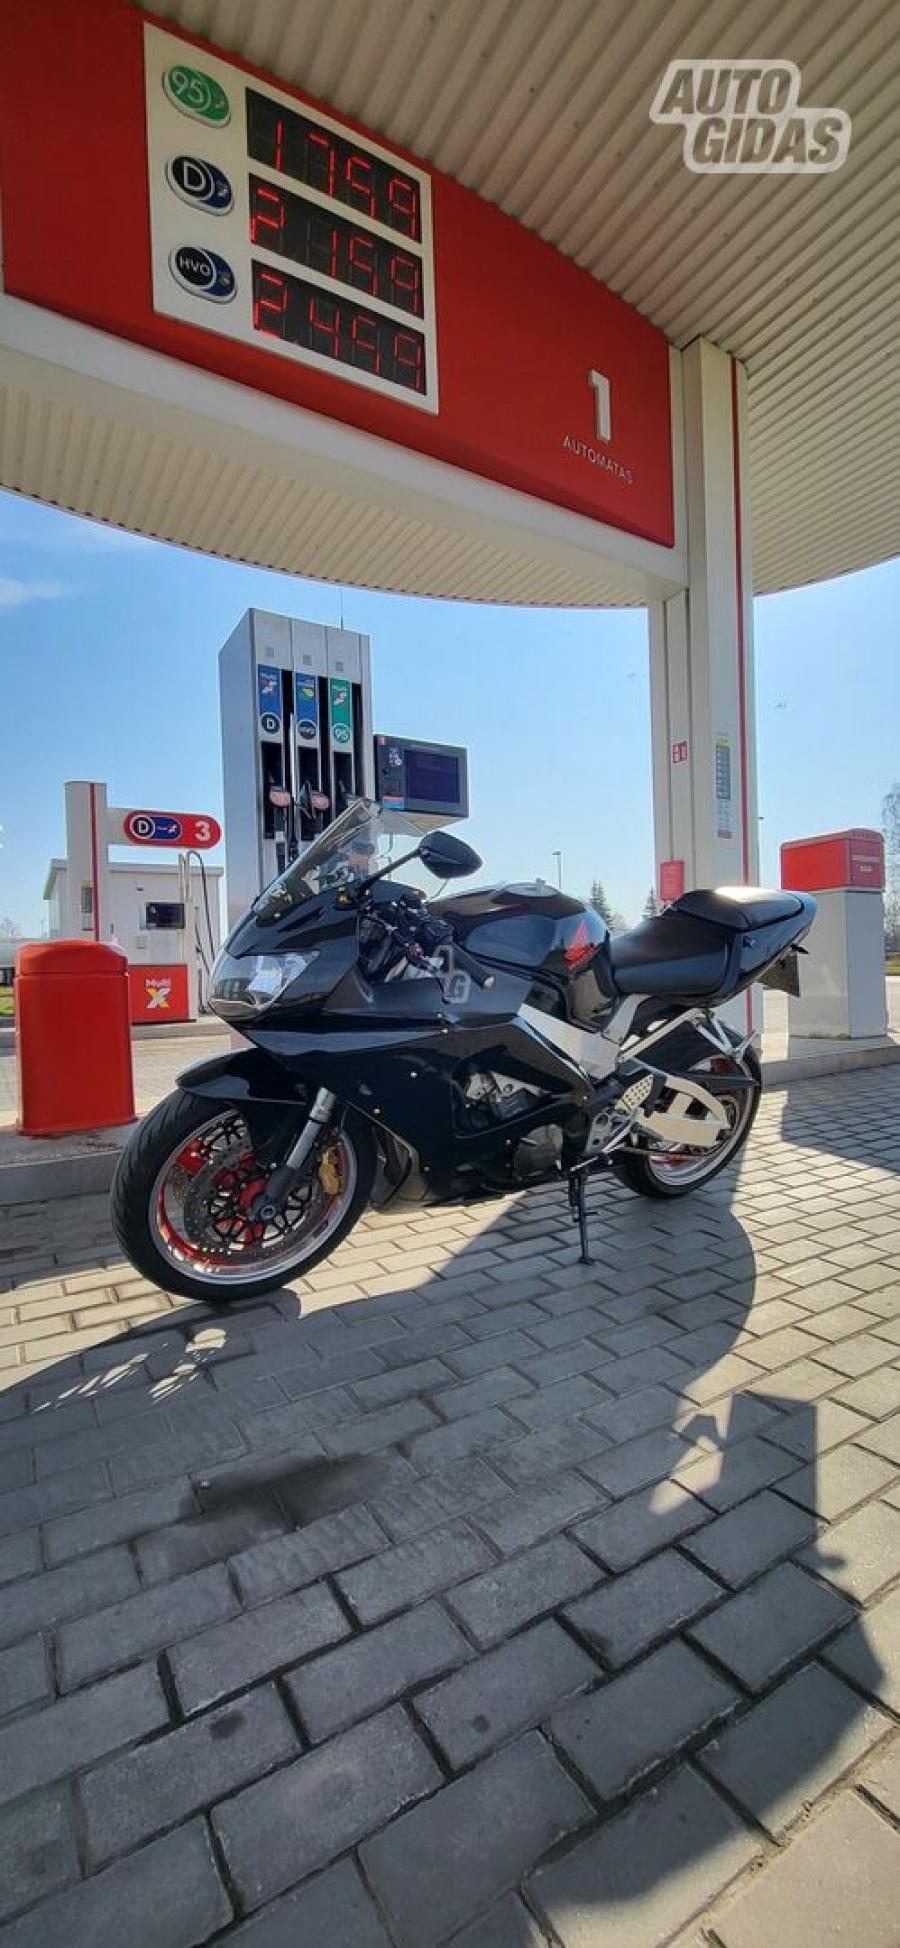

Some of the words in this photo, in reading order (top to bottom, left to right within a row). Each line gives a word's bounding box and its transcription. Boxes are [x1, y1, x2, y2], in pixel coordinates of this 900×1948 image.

[172, 71, 206, 103] 95
[183, 159, 206, 192] D
[179, 255, 210, 277] HVO
[587, 368, 612, 443] 1
[562, 434, 634, 485] AUTOMATAS
[266, 717, 276, 730] D
[138, 820, 149, 834] D
[194, 820, 211, 841] 3
